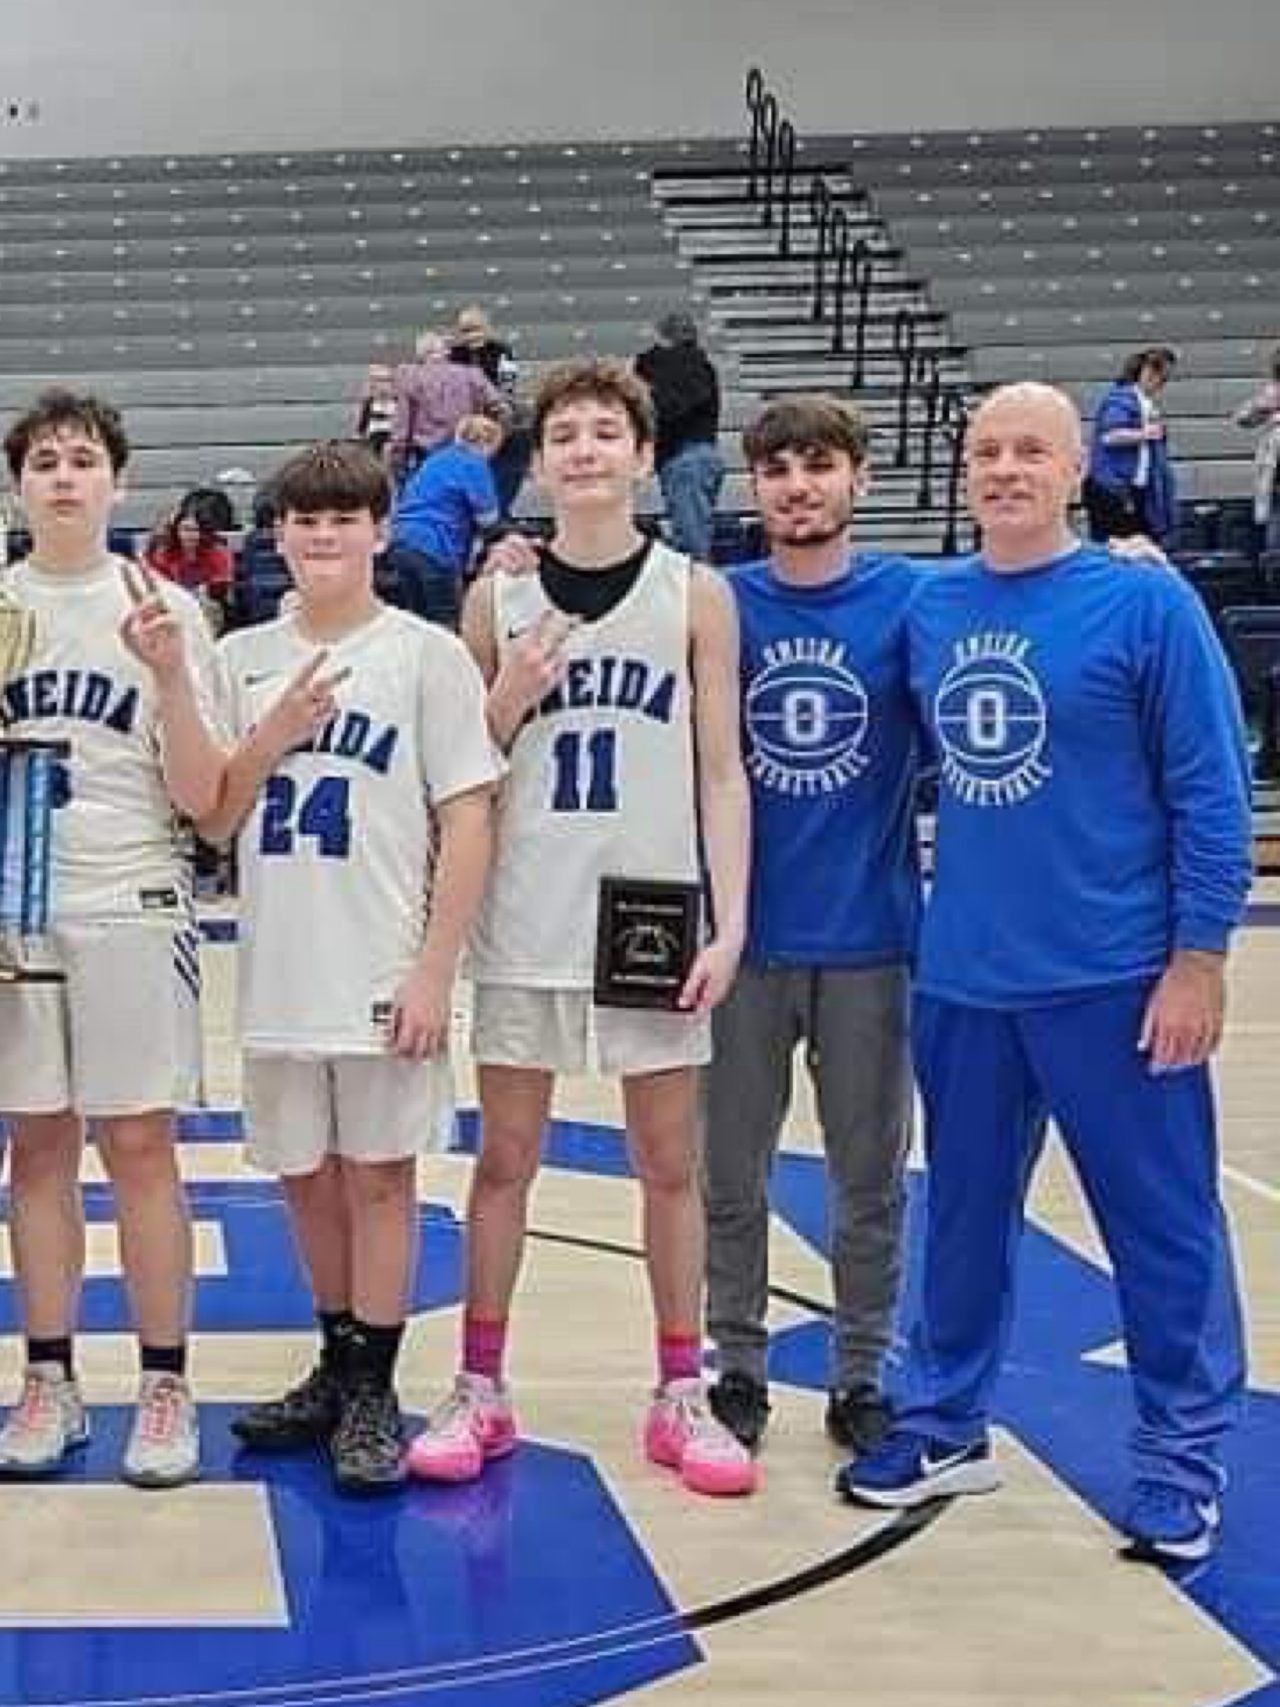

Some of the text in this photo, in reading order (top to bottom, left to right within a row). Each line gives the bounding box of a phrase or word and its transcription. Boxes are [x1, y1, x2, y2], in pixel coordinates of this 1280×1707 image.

[522, 656, 677, 724] EIDA
[553, 728, 617, 813] 11
[260, 776, 351, 857] 24
